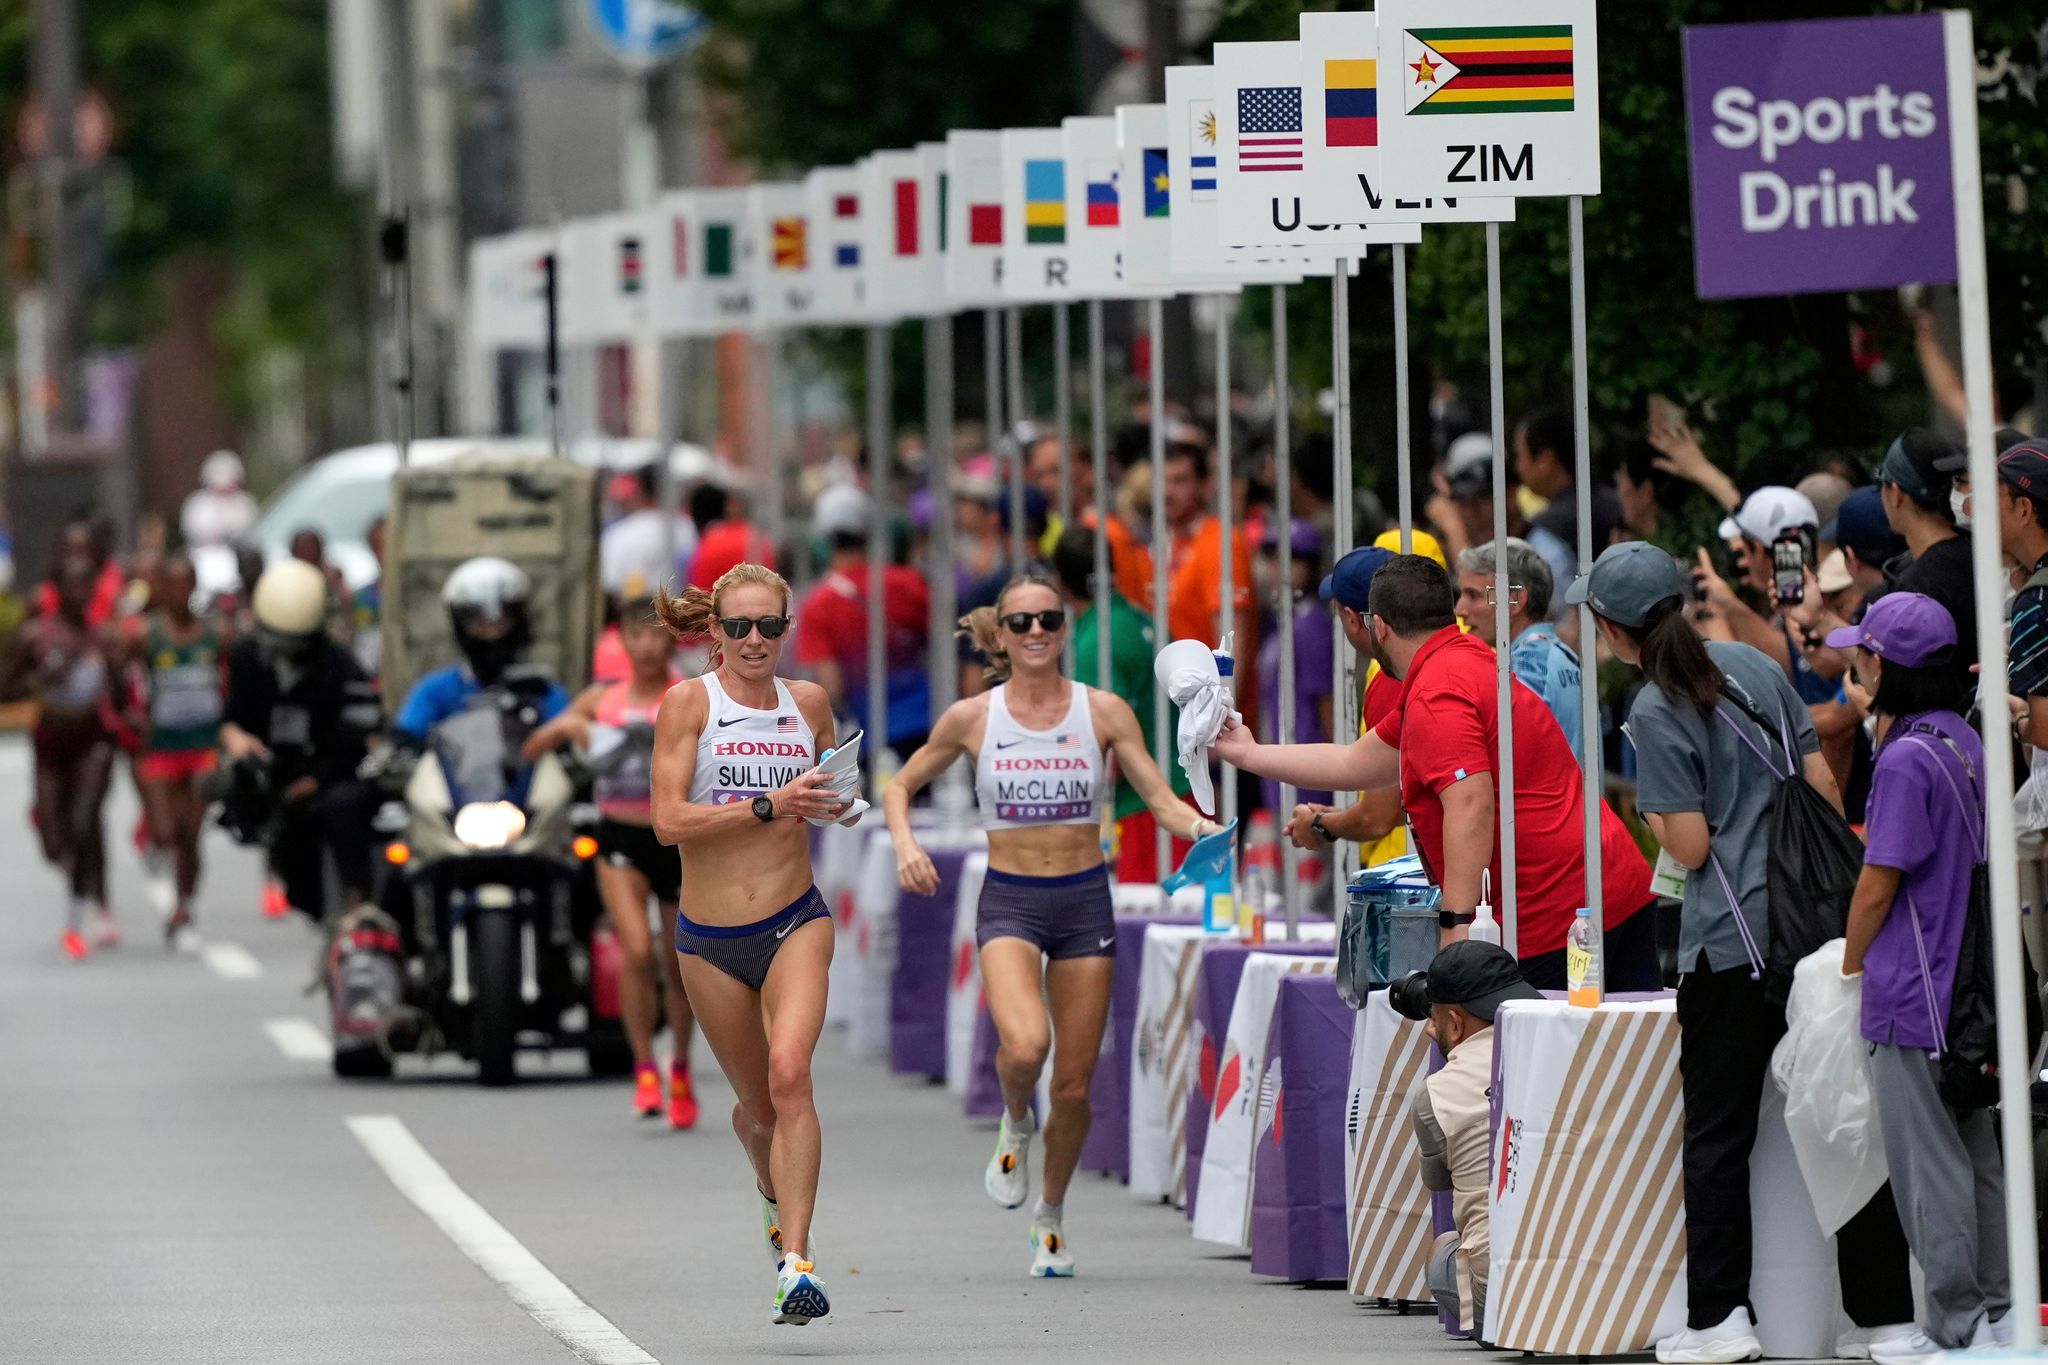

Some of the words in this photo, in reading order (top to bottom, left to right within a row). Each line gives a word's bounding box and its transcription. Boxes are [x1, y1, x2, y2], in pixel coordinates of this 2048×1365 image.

[1711, 83, 1936, 162] Sports
[1446, 143, 1534, 183] ZIM
[1739, 164, 1919, 233] Drink
[714, 741, 810, 758] HONDA
[994, 758, 1089, 771] HONDA
[998, 780, 1089, 801] McCLAIN
